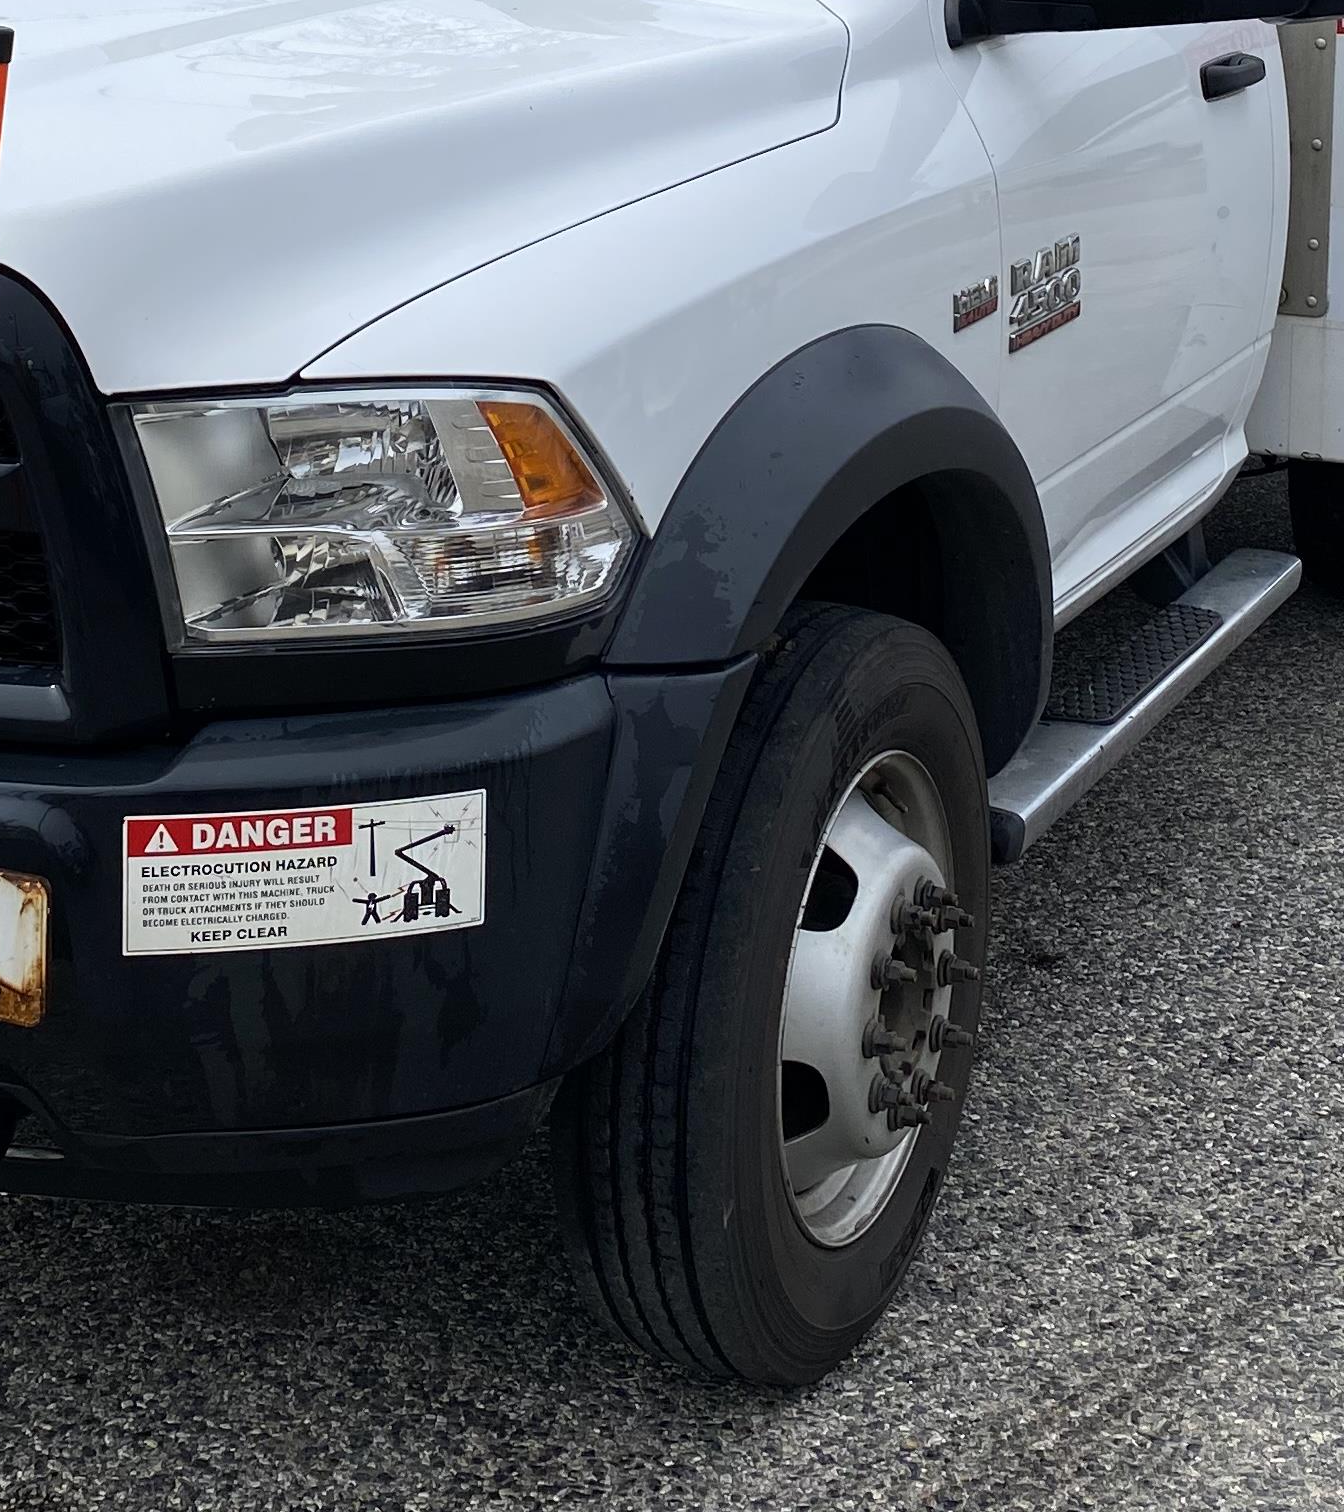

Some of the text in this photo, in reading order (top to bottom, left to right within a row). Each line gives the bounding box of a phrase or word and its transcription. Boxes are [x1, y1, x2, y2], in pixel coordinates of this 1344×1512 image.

[1011, 232, 1080, 296] RAM
[1009, 266, 1081, 326] 4500
[193, 815, 336, 850] DANGER
[141, 856, 337, 878] ELECTROCUTION HAZARD
[143, 875, 319, 892] DEATH OR SERIOUS INJURY WILL RESULT
[171, 894, 210, 903] CONTACT
[213, 892, 235, 901] WITH
[238, 891, 258, 899] THIS
[307, 886, 335, 895] TRUCK
[143, 898, 325, 916] OR TRUCK ATTACHMENTS IF THEY SHOULD
[143, 918, 178, 927] BECOME
[181, 915, 243, 926] ELECTRICALLY
[191, 926, 287, 942] KEEP CLEAR
